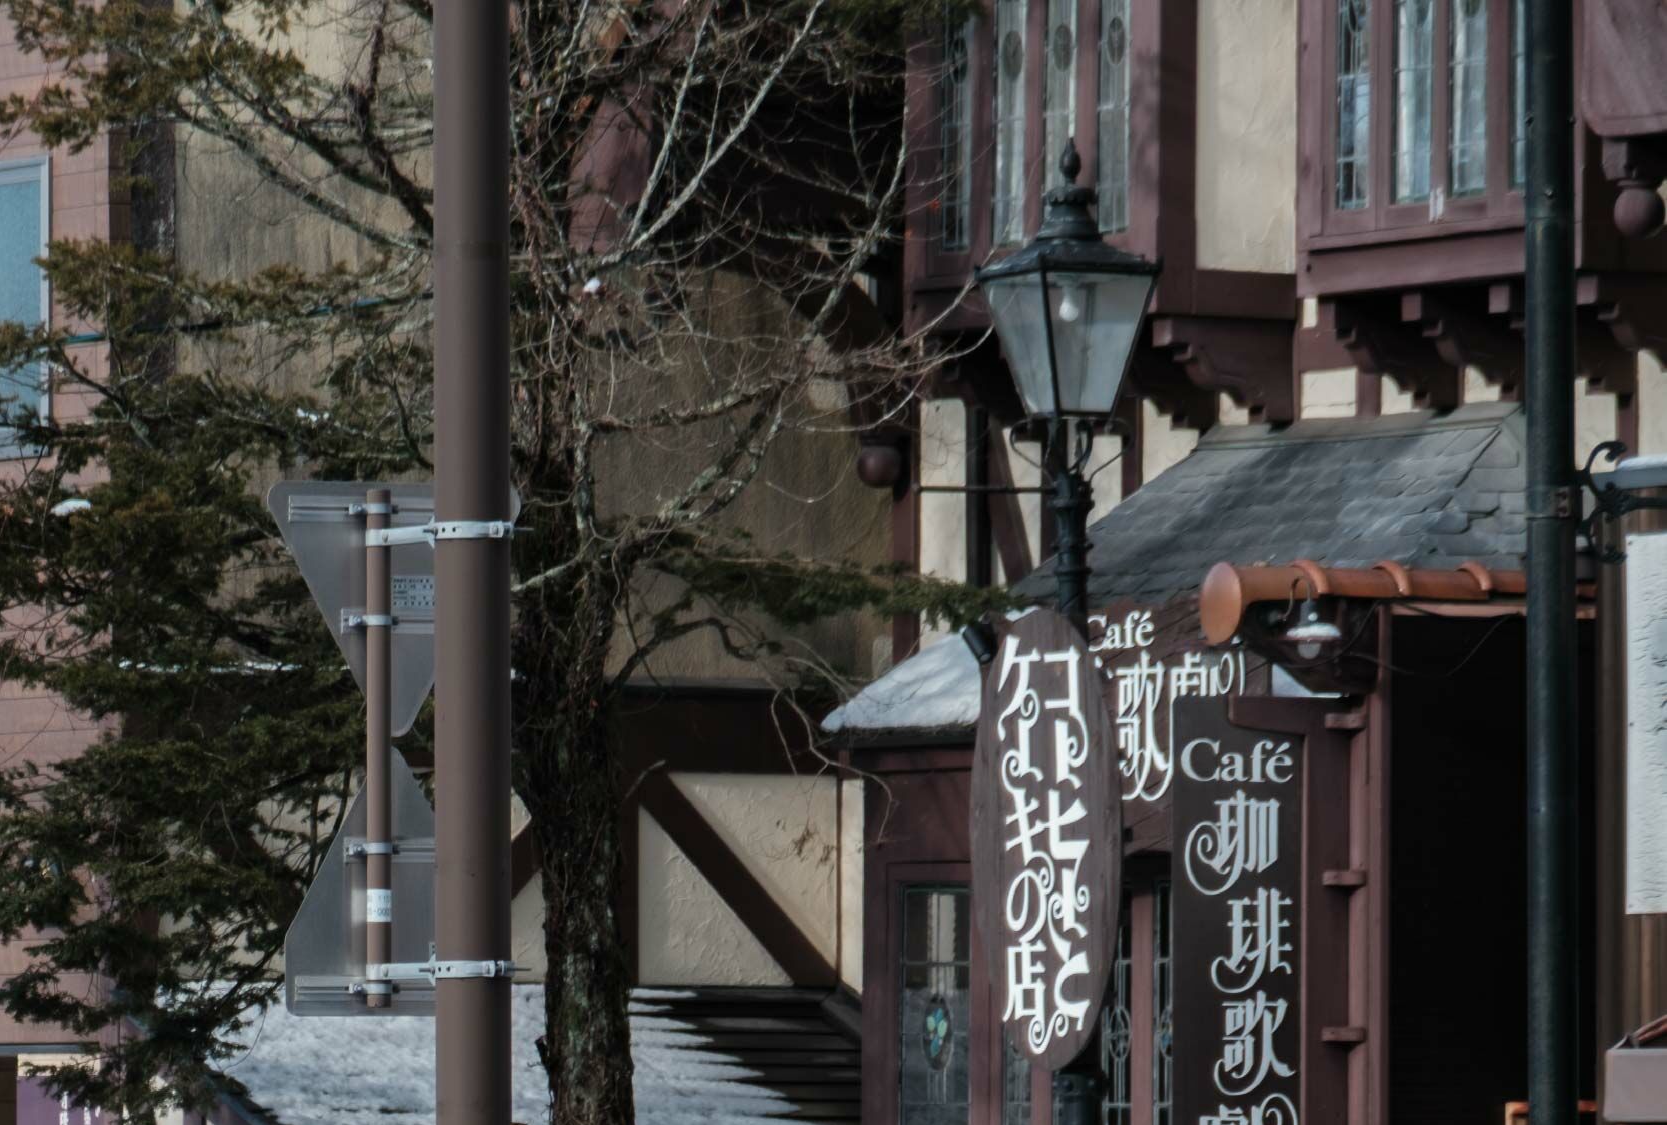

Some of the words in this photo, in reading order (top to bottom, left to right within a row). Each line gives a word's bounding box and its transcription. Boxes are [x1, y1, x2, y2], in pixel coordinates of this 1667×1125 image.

[1087, 610, 1155, 652] Café
[1181, 737, 1294, 784] Café
[998, 634, 1069, 1055] ケーキの店
